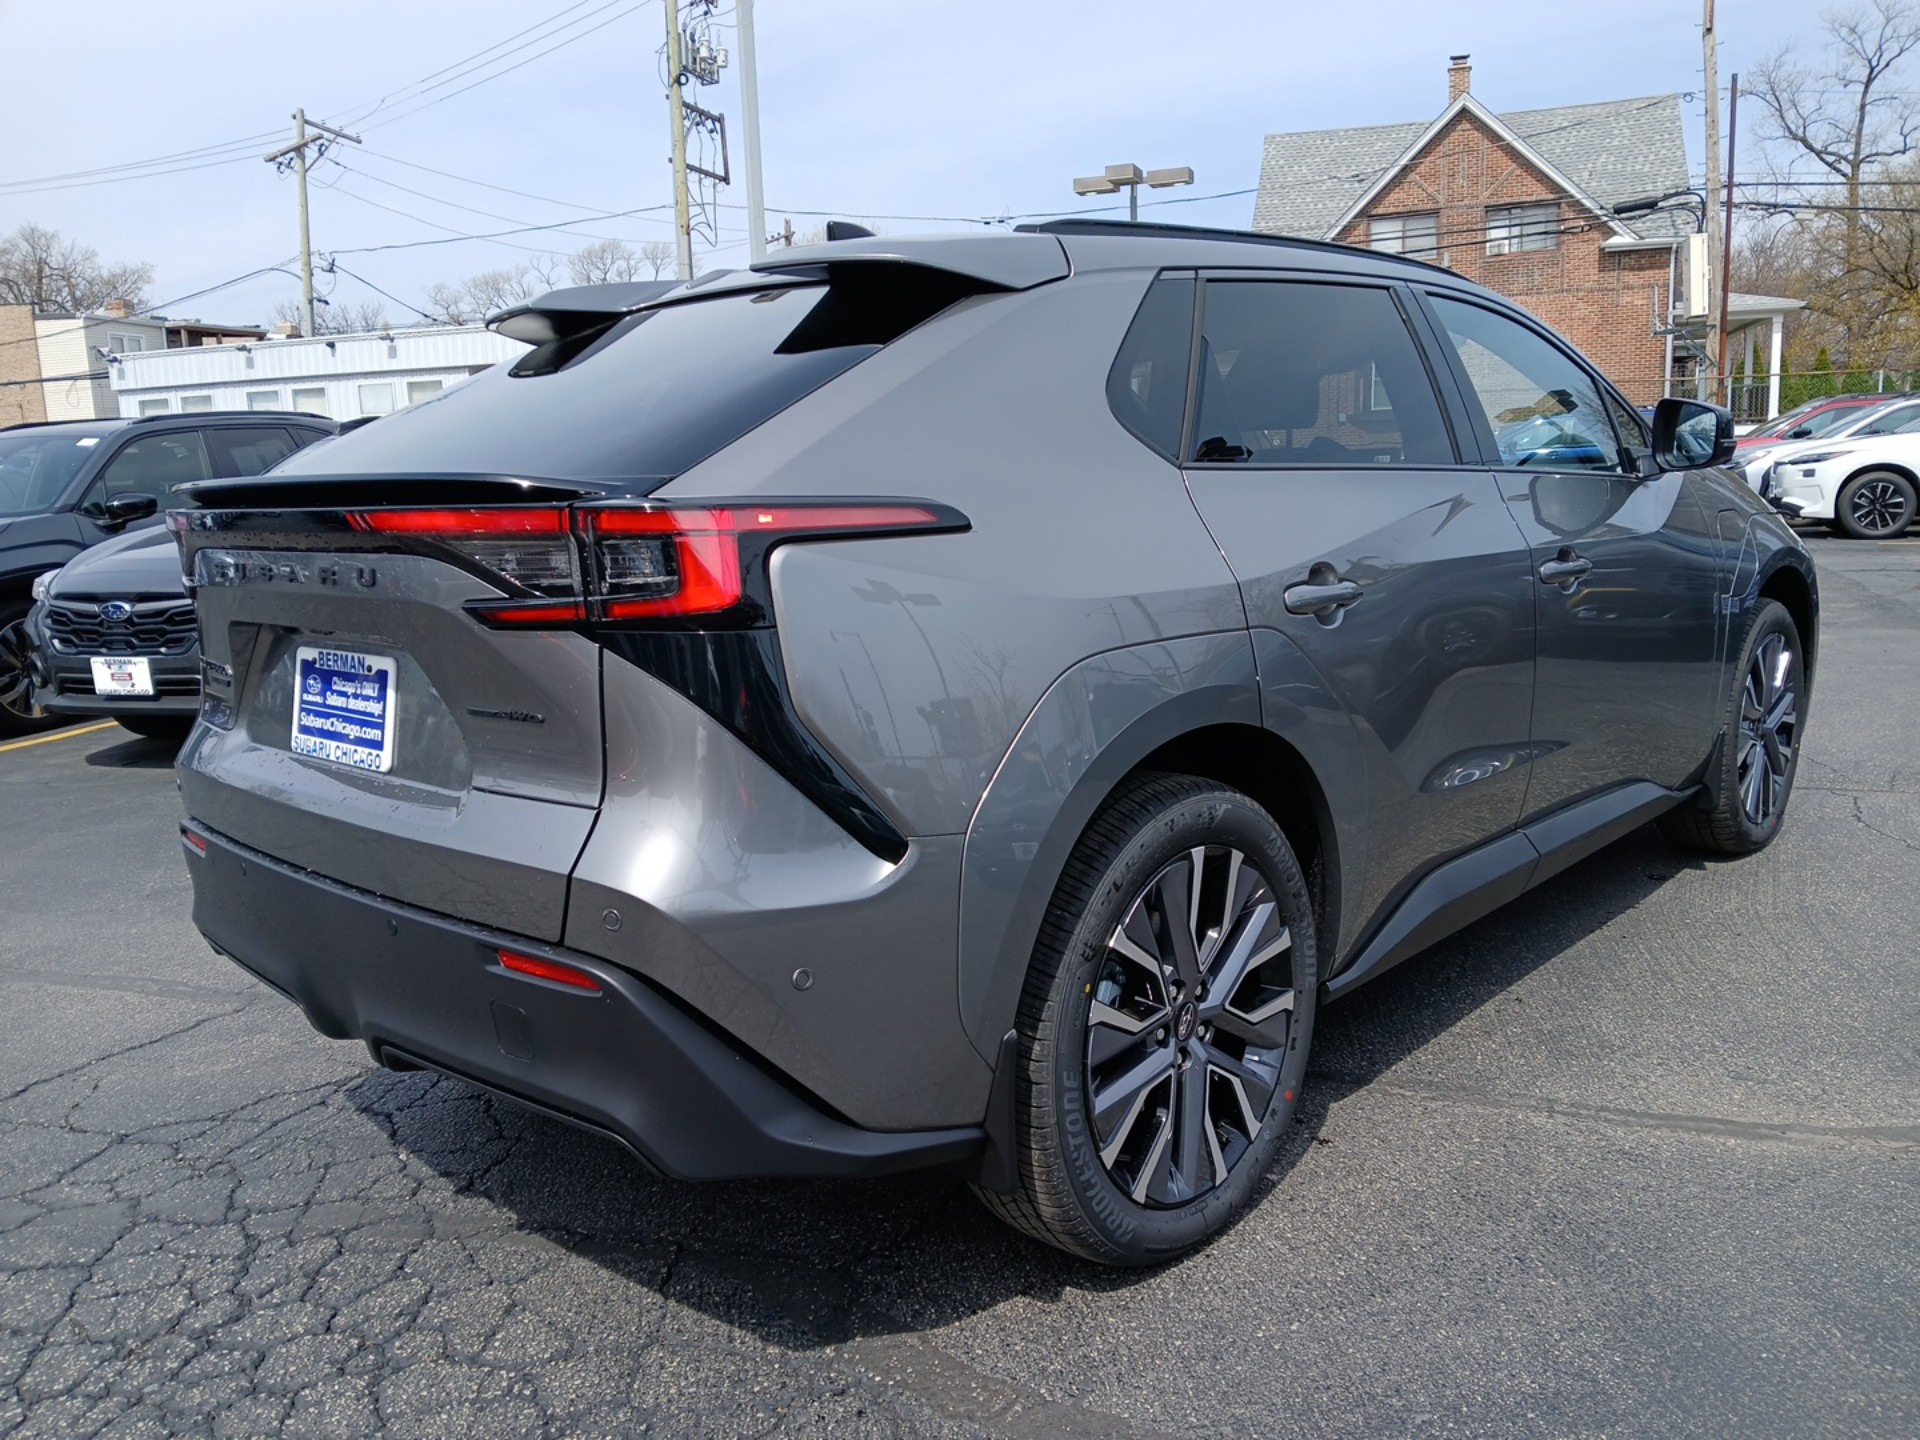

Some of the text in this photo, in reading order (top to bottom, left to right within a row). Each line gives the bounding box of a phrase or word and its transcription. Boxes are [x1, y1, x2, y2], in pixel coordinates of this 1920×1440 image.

[318, 651, 366, 673] BERMAN
[325, 692, 347, 708] Subaru
[300, 712, 382, 741] SubaruChicago.com
[293, 736, 382, 770] SUBARU CHICAGO
[1063, 1070, 1138, 1244] BRIDGESTONE
